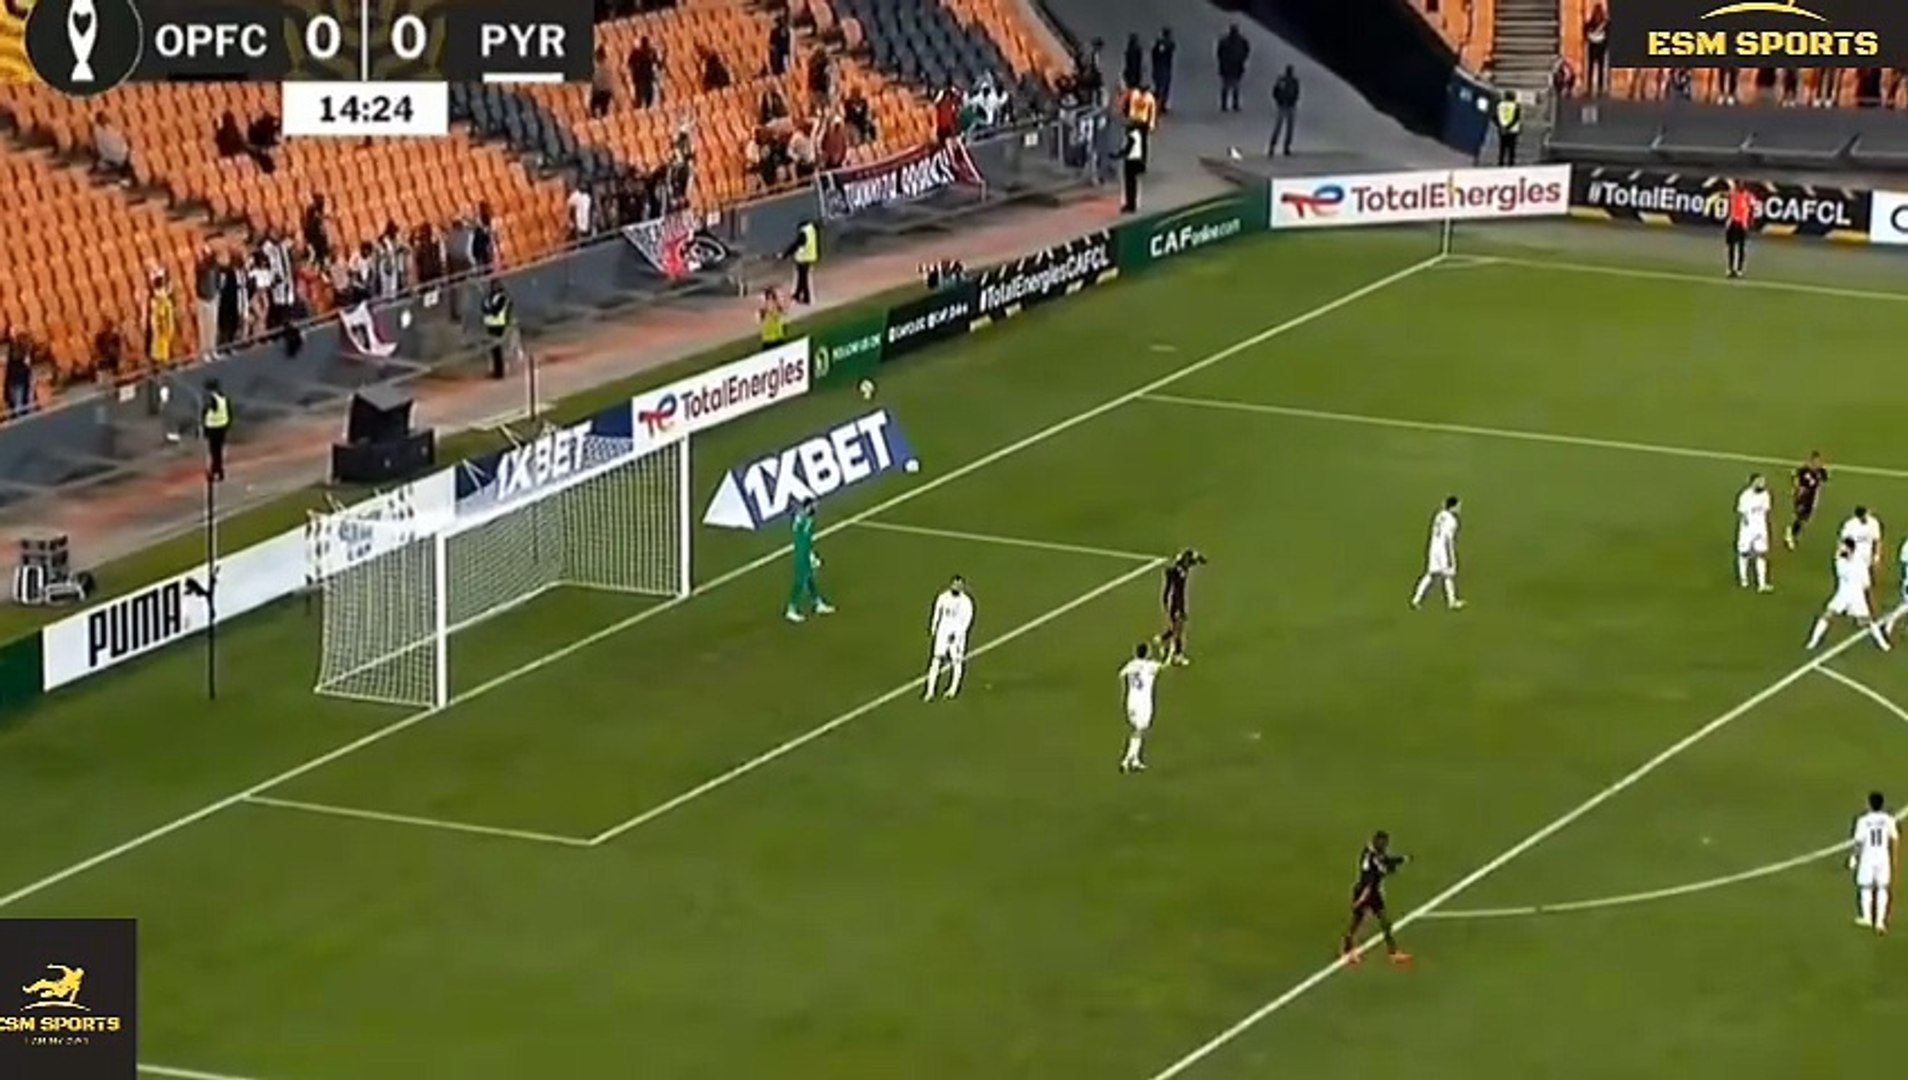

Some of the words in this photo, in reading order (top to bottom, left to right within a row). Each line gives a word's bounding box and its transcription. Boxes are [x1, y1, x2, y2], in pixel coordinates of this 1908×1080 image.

[1352, 177, 1562, 213] TotalEnergies
[1588, 181, 1851, 226] #TotalEnergsCAFCL
[680, 356, 805, 420] TotalEnergies
[743, 409, 890, 521] 1XBET
[88, 580, 181, 667] PUMA
[1869, 828, 1883, 847] 11
